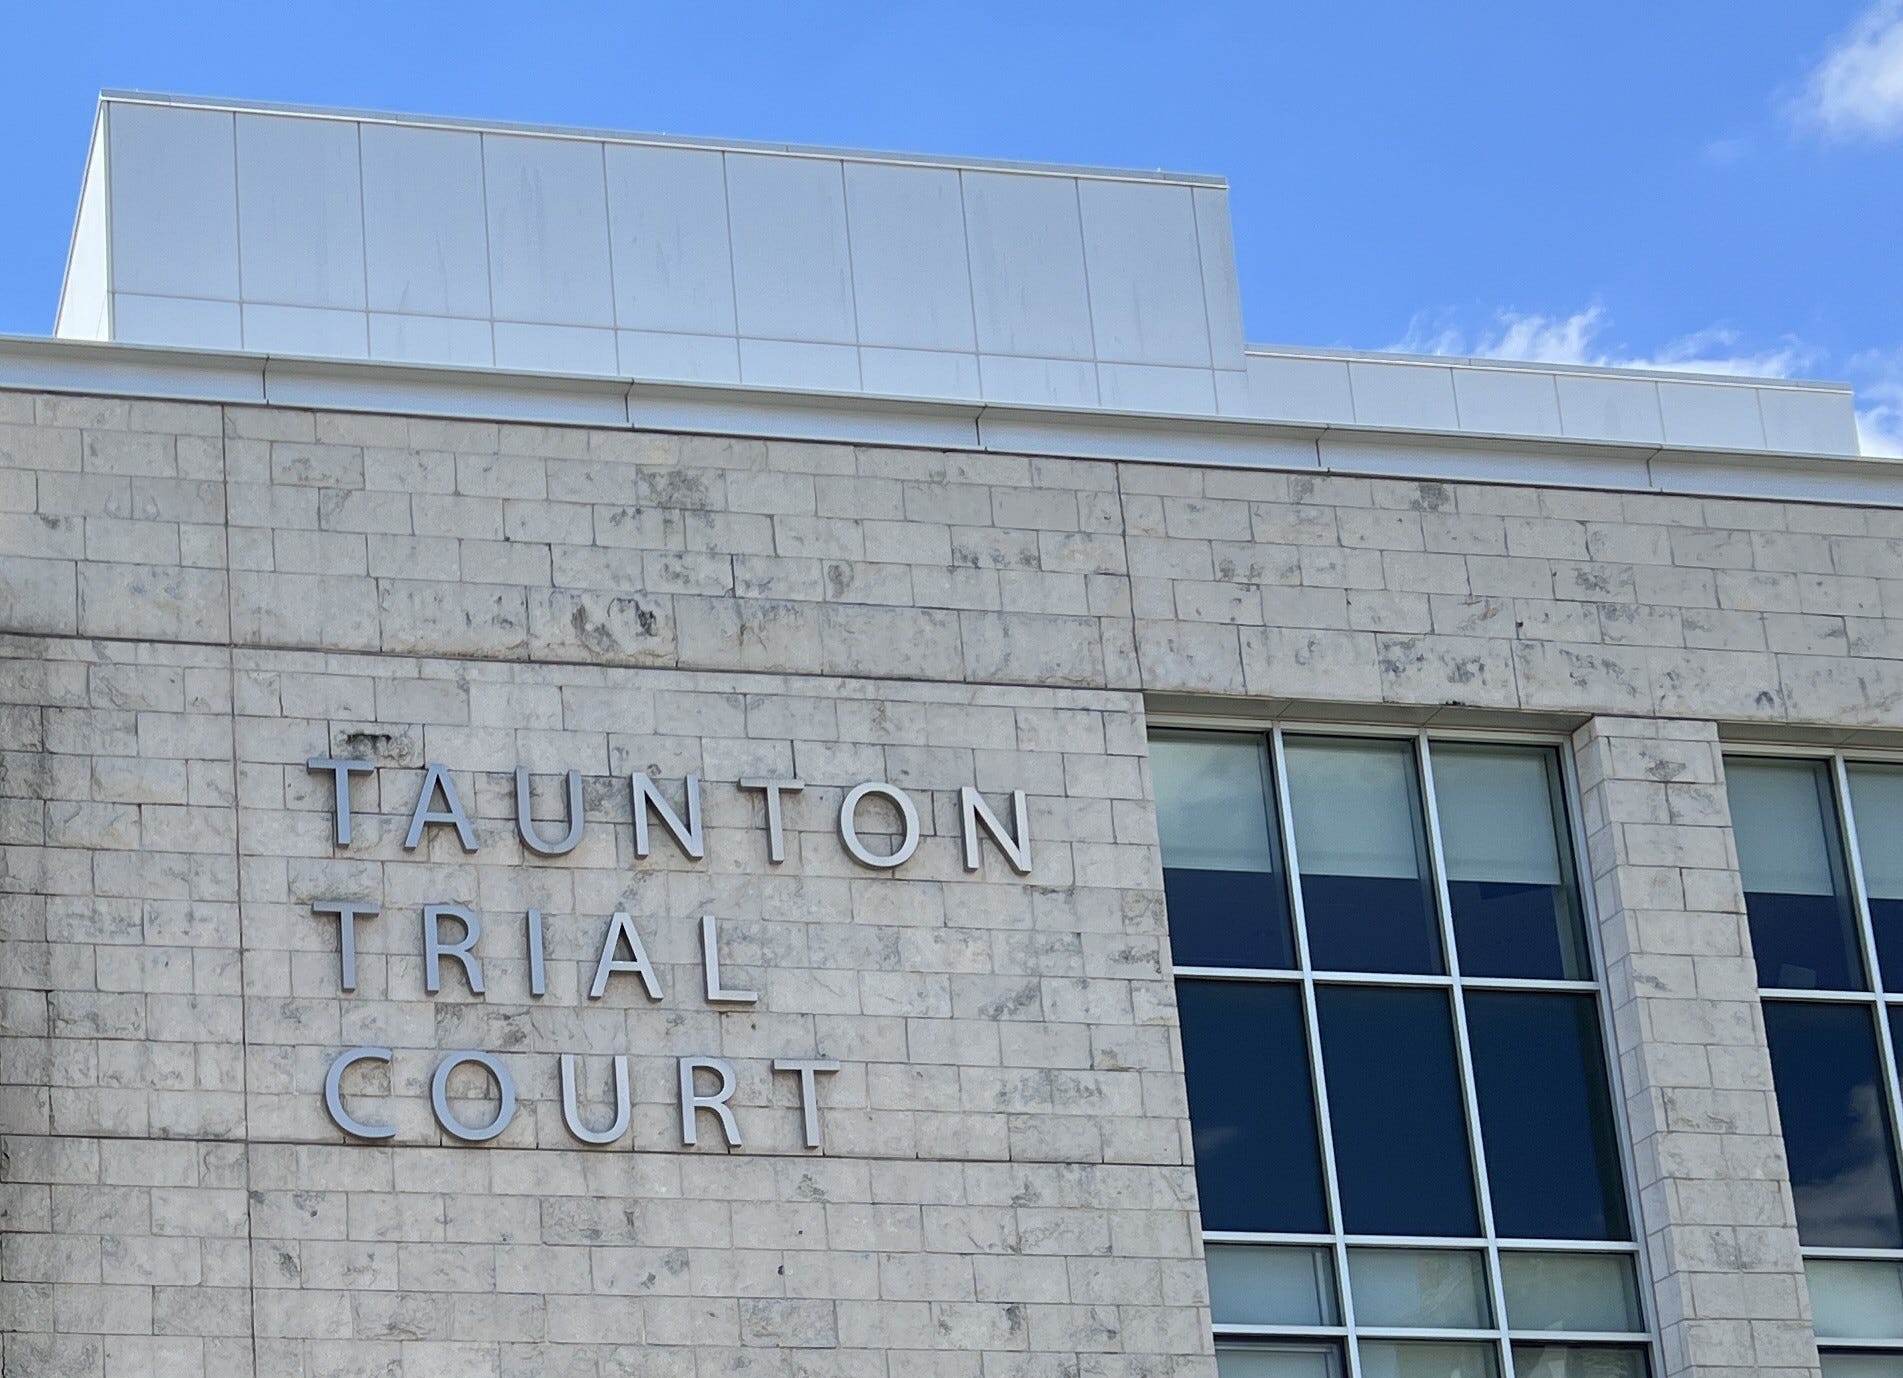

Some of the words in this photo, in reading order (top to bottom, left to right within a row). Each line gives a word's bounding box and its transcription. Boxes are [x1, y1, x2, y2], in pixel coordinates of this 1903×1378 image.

[307, 757, 1033, 876] TAUNTON
[313, 901, 759, 1004] TRIAL
[325, 1047, 840, 1148] COURT
